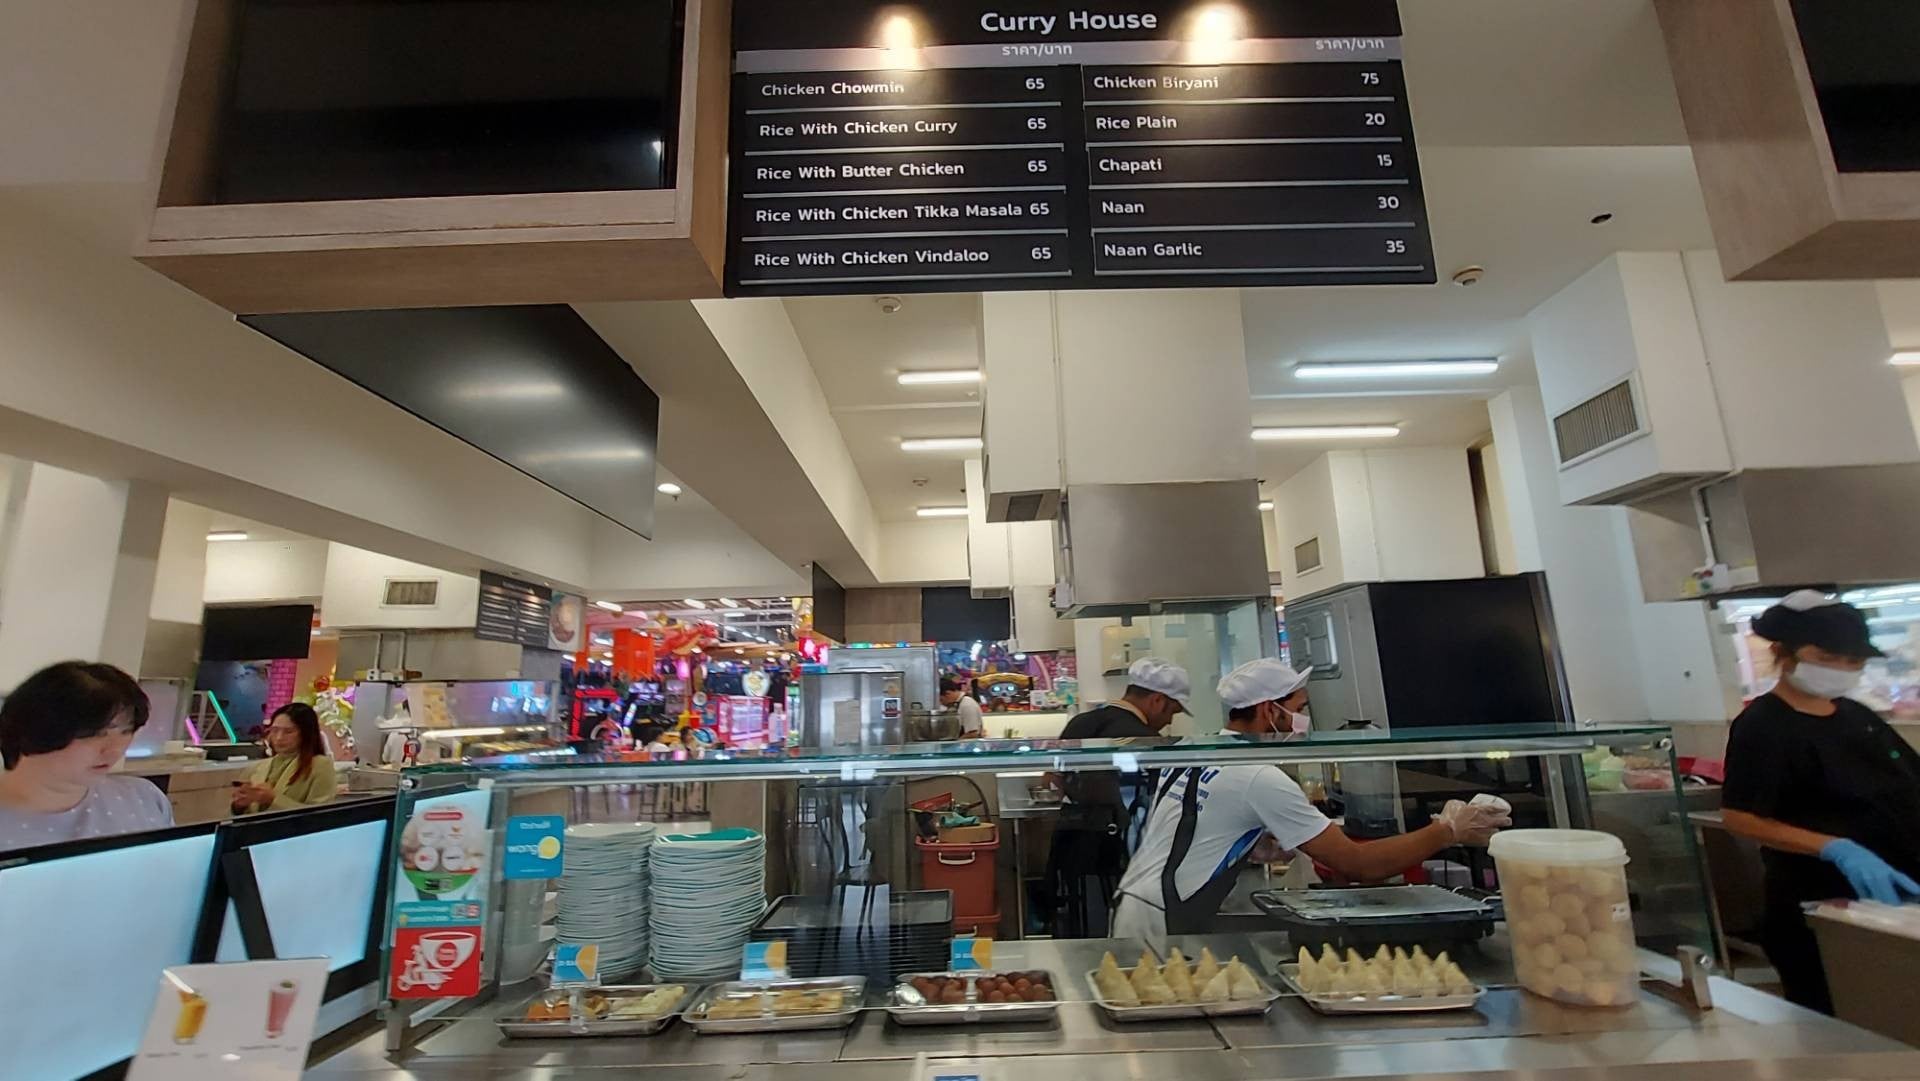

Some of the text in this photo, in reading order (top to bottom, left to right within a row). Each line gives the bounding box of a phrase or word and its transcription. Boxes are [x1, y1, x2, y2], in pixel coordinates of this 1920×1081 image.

[980, 10, 1158, 35] Curry House
[761, 77, 1045, 96] Chicken Chowmin 65
[1093, 72, 1380, 91] Chicken Biryani 75
[759, 117, 1047, 137] Rice With Chicken Curry 65
[1095, 112, 1386, 130] Rice Plain 20
[756, 159, 1048, 180] Rice With Butter Chicken 65
[1098, 154, 1393, 175] Chapati 15
[755, 202, 1050, 222] Rice With Chicken Tikka Masala 65
[1101, 195, 1400, 214] Naan 30
[754, 246, 1052, 266] Rice With Chicken Vindaloo 65
[1104, 240, 1406, 257] Naan Garlic 35
